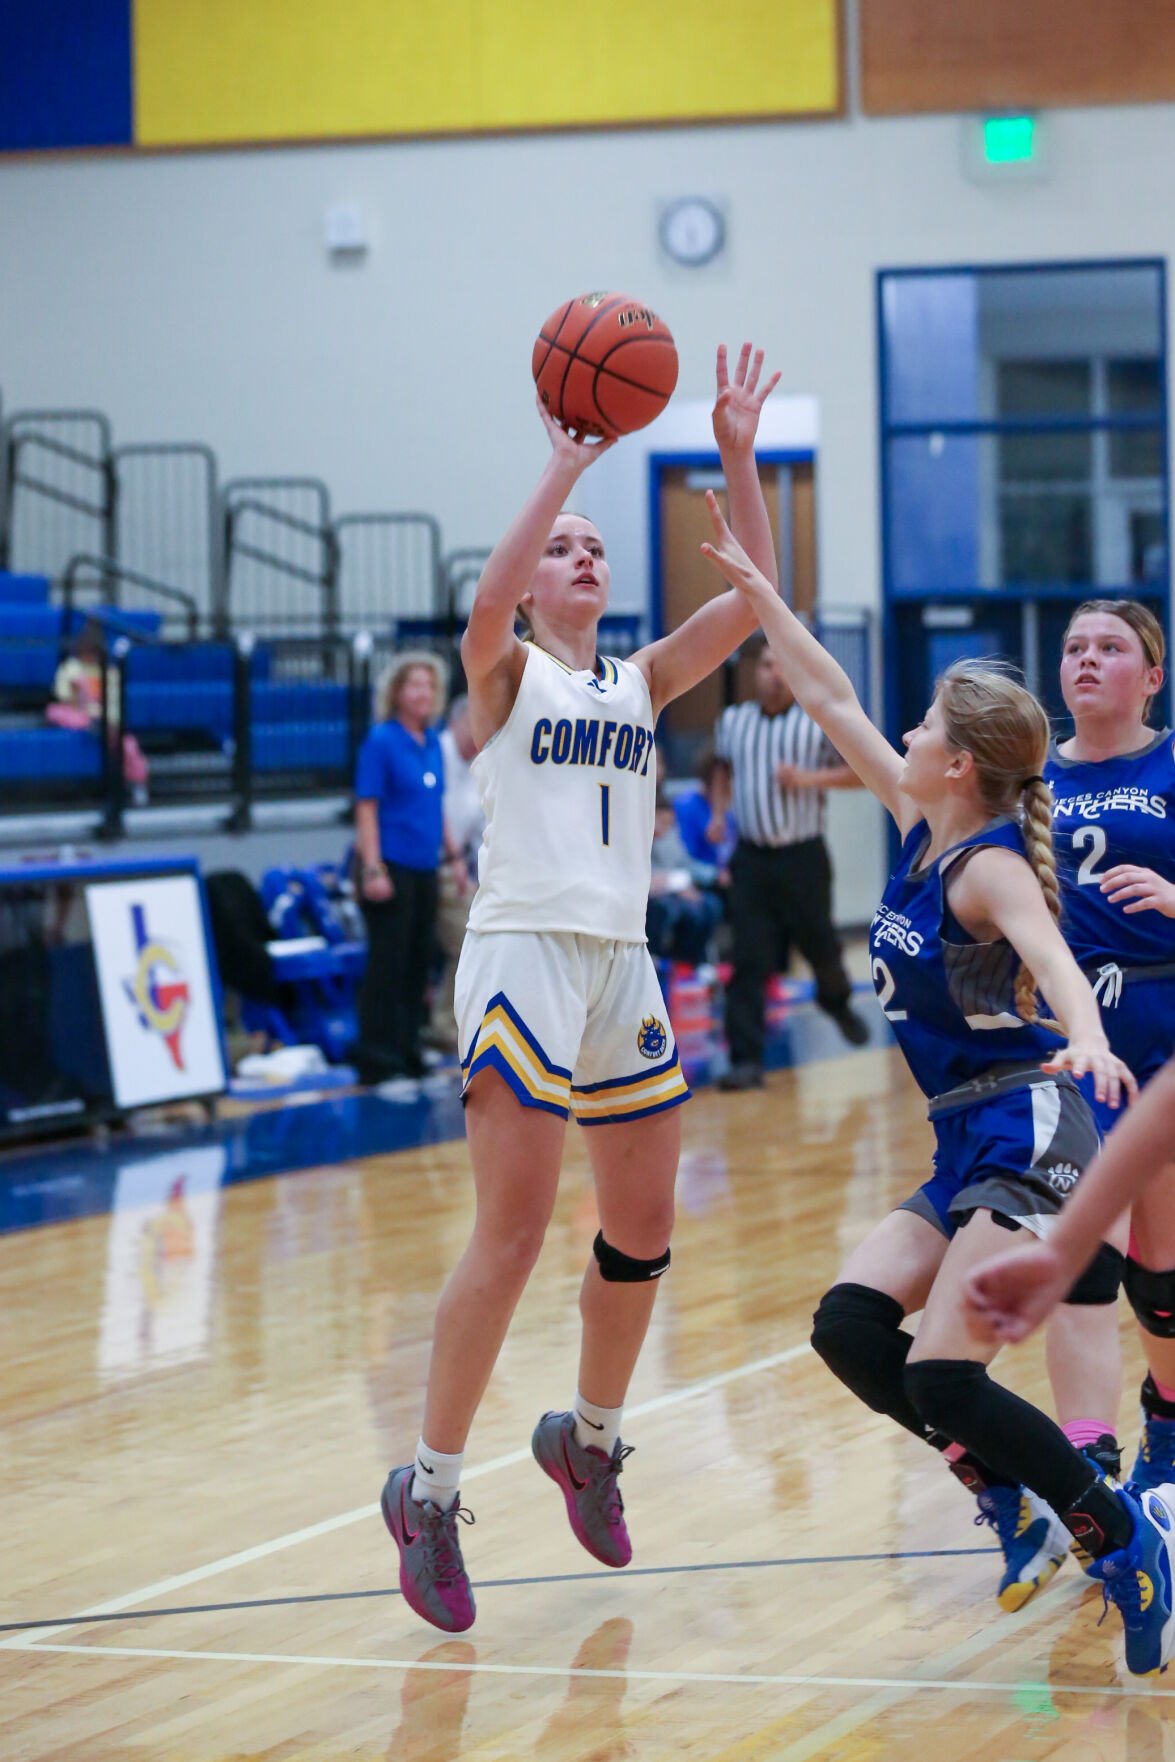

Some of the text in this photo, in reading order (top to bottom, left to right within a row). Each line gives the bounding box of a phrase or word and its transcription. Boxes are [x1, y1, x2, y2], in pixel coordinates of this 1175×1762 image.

[530, 718, 654, 777] COMFORT
[598, 782, 611, 848] 1
[1052, 794, 1167, 820] NTHERS
[1096, 786, 1149, 799] CANYON
[1072, 825, 1107, 886] 2
